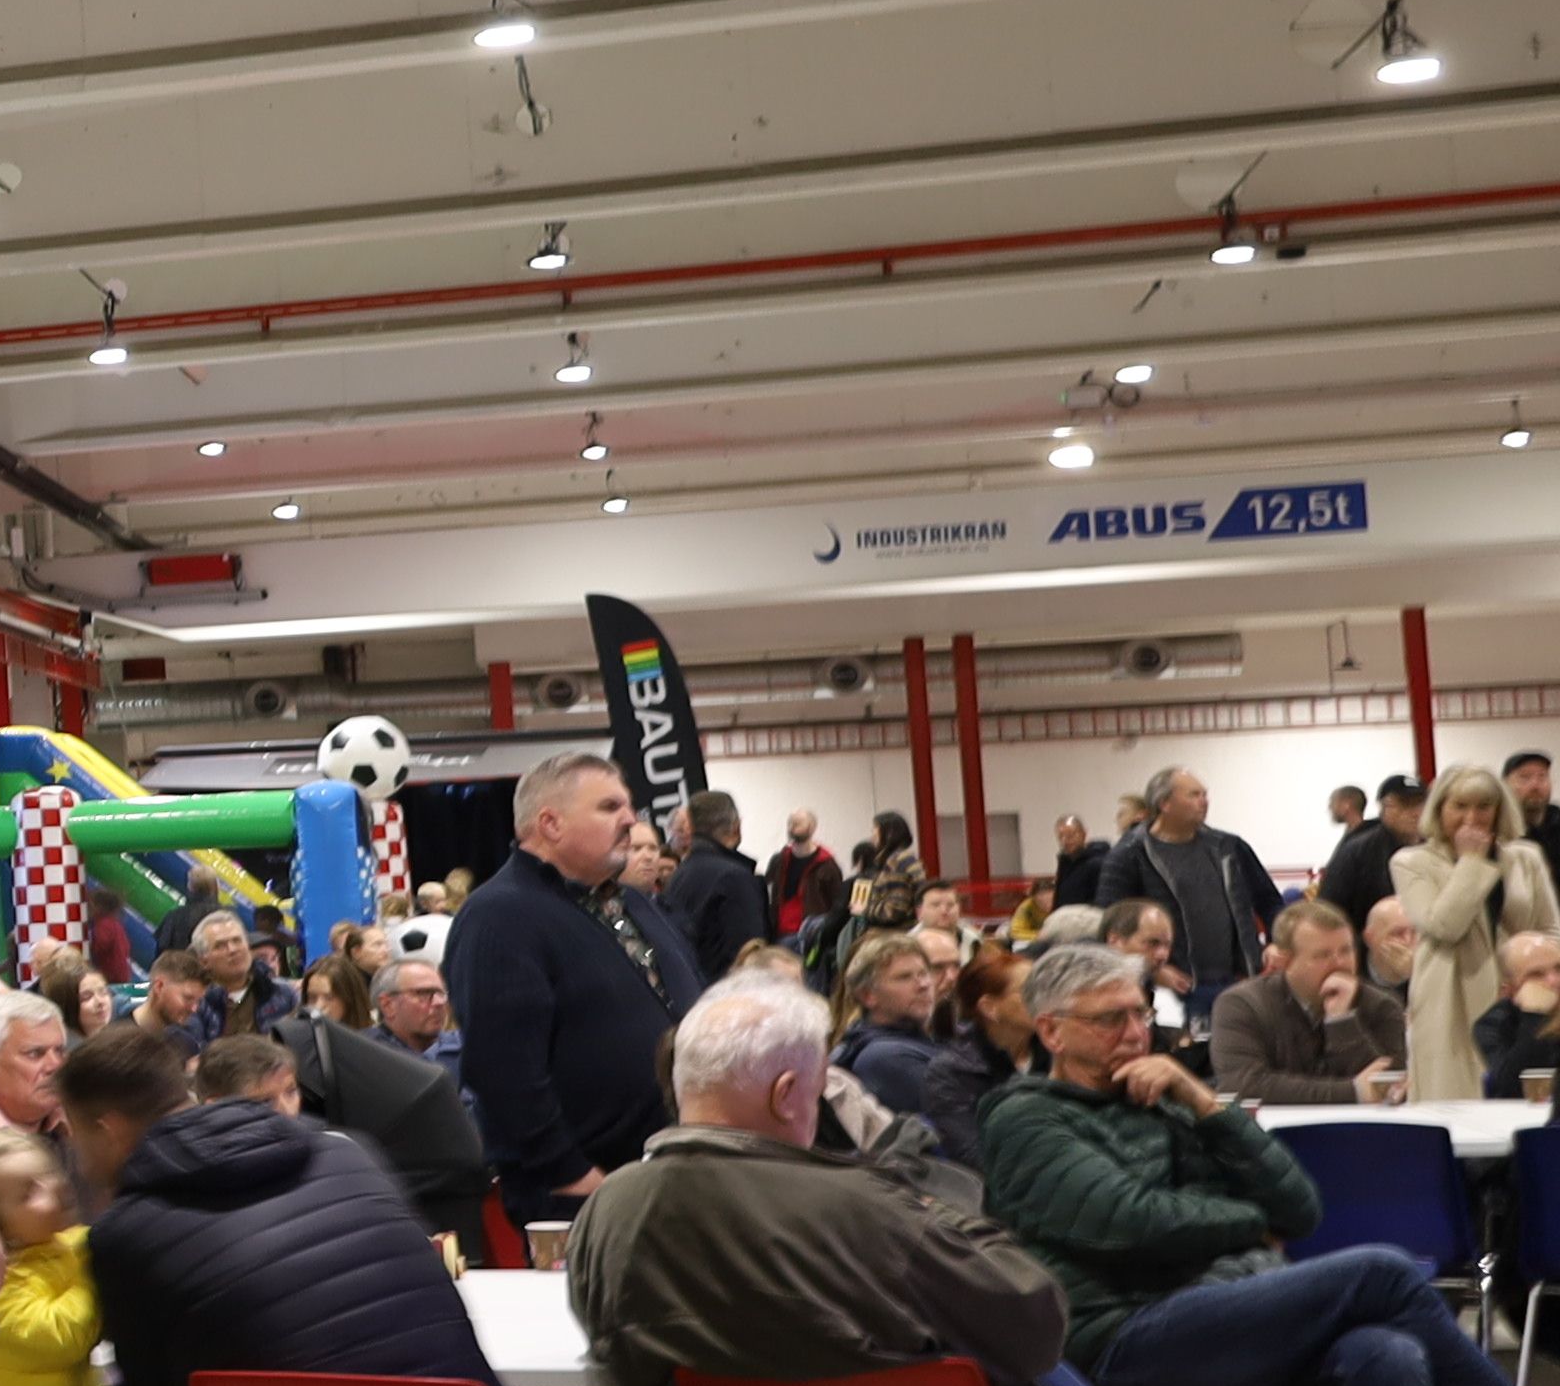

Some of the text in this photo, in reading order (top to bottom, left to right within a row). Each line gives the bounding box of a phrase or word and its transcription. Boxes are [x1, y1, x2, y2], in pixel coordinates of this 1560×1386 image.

[856, 519, 1008, 549] INDUSTRIKRAN
[1049, 489, 1352, 544] ABUS 12,5t
